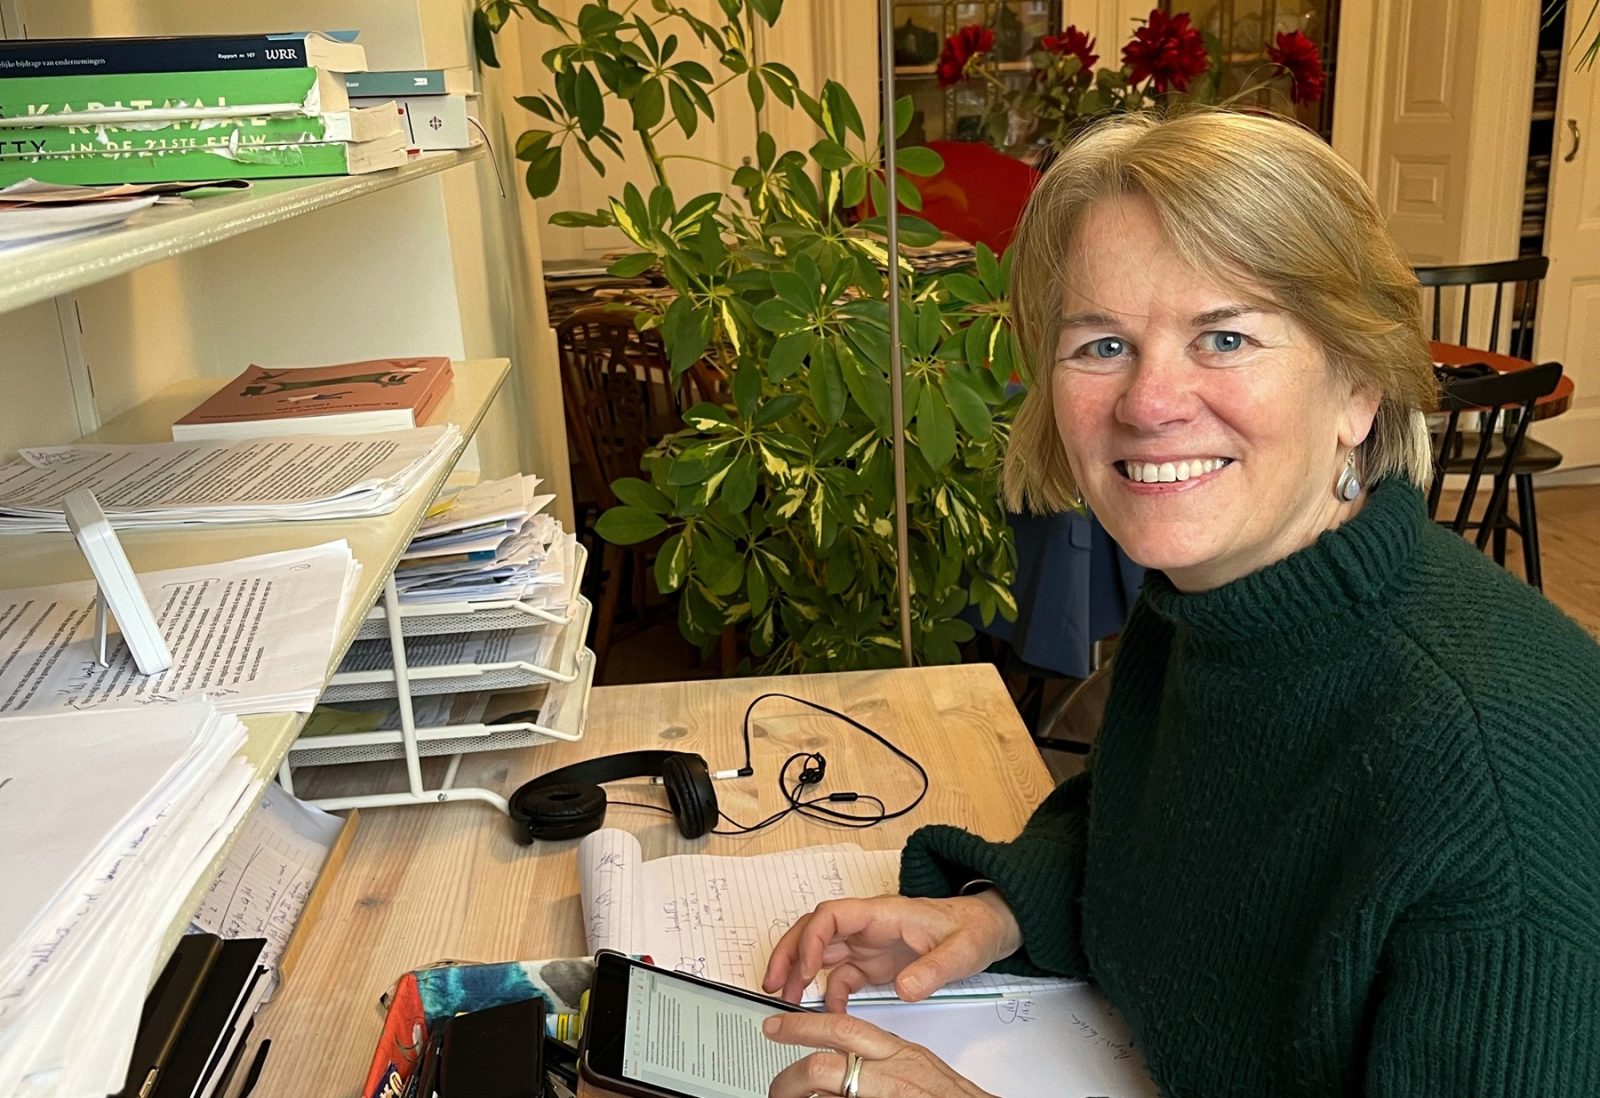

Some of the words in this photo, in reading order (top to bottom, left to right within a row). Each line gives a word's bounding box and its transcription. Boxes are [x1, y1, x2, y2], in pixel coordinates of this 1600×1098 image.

[265, 48, 298, 60] WRR
[16, 60, 41, 69] bijdrage
[55, 58, 106, 66] ondernemingen
[69, 142, 95, 159] IN
[103, 140, 133, 160] DE
